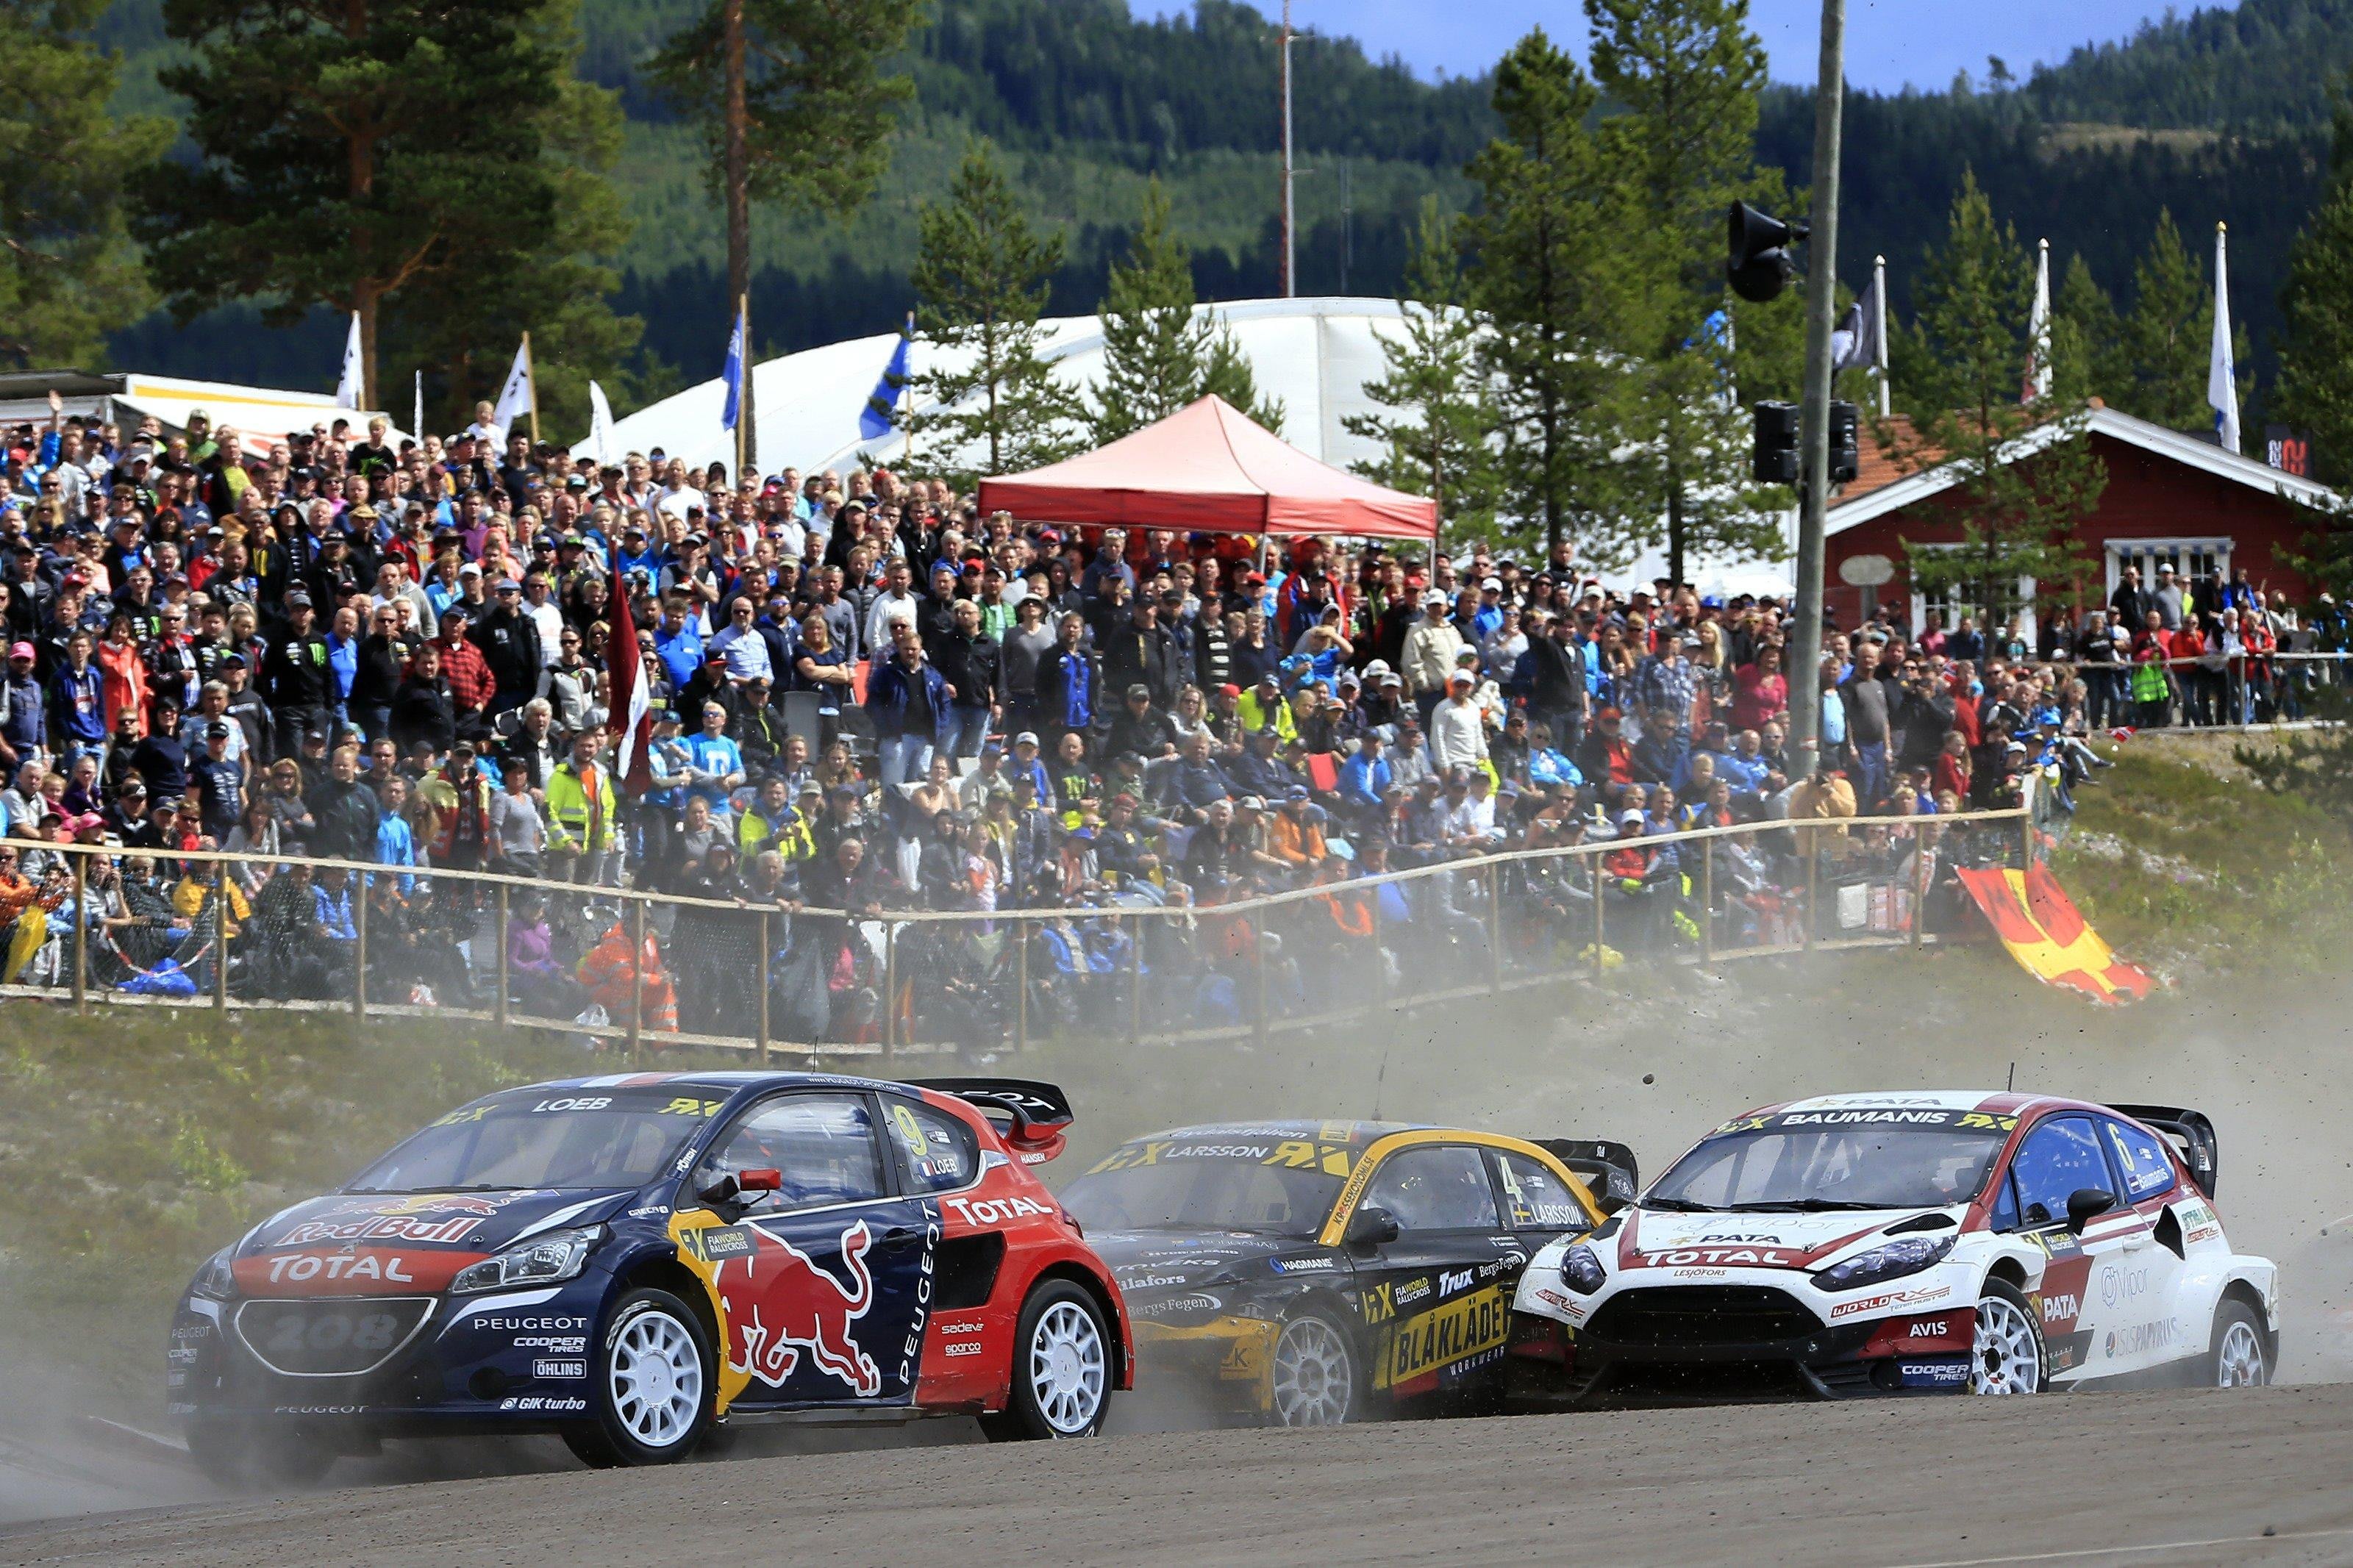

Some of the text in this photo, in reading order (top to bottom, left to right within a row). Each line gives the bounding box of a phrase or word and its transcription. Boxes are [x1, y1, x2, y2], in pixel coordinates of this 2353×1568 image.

[532, 1098, 614, 1112] LOEB
[1781, 1111, 1951, 1126] BAUMANIS
[893, 1106, 927, 1156] 9
[1165, 1146, 1269, 1159] LARSSON
[2107, 1123, 2135, 1172] 6
[934, 1158, 957, 1175] LOEB
[1021, 1152, 1046, 1164] HANSEN
[1499, 1156, 1524, 1204] 4
[946, 1196, 1054, 1227] TOTAL
[1530, 1204, 1582, 1225] LARSSON
[274, 1217, 486, 1247] Red Bull
[1699, 1234, 1782, 1244] PATA
[710, 1240, 749, 1253] RALLYCROSS
[1282, 1257, 1333, 1271] HAGMANS
[1479, 1253, 1521, 1278] Bergs Fegen
[1643, 1250, 1790, 1267] TOTAL
[269, 1254, 414, 1283] TOTAL
[1674, 1268, 1727, 1278] LESJÖFORS
[1117, 1274, 1187, 1292] ilafors
[1438, 1268, 1474, 1298] Trux
[899, 1200, 940, 1385] PEUGEOT
[1396, 1286, 1430, 1306] RALLYCROSS
[1126, 1296, 1209, 1317] Bergs Fegen
[2043, 1294, 2079, 1322] PATA
[266, 1314, 398, 1350] 208
[474, 1317, 587, 1330] PEUGEOT
[941, 1322, 984, 1334] sadev
[1910, 1321, 1947, 1337] AVIS
[513, 1336, 586, 1347] COOPER
[945, 1342, 981, 1356] sparco
[537, 1361, 583, 1375] ÖHLINS
[1449, 1345, 1504, 1376] WORKWEAR
[1902, 1364, 1969, 1375] COOPER
[1933, 1373, 1968, 1381] TIRES
[545, 1397, 586, 1410] turbo
